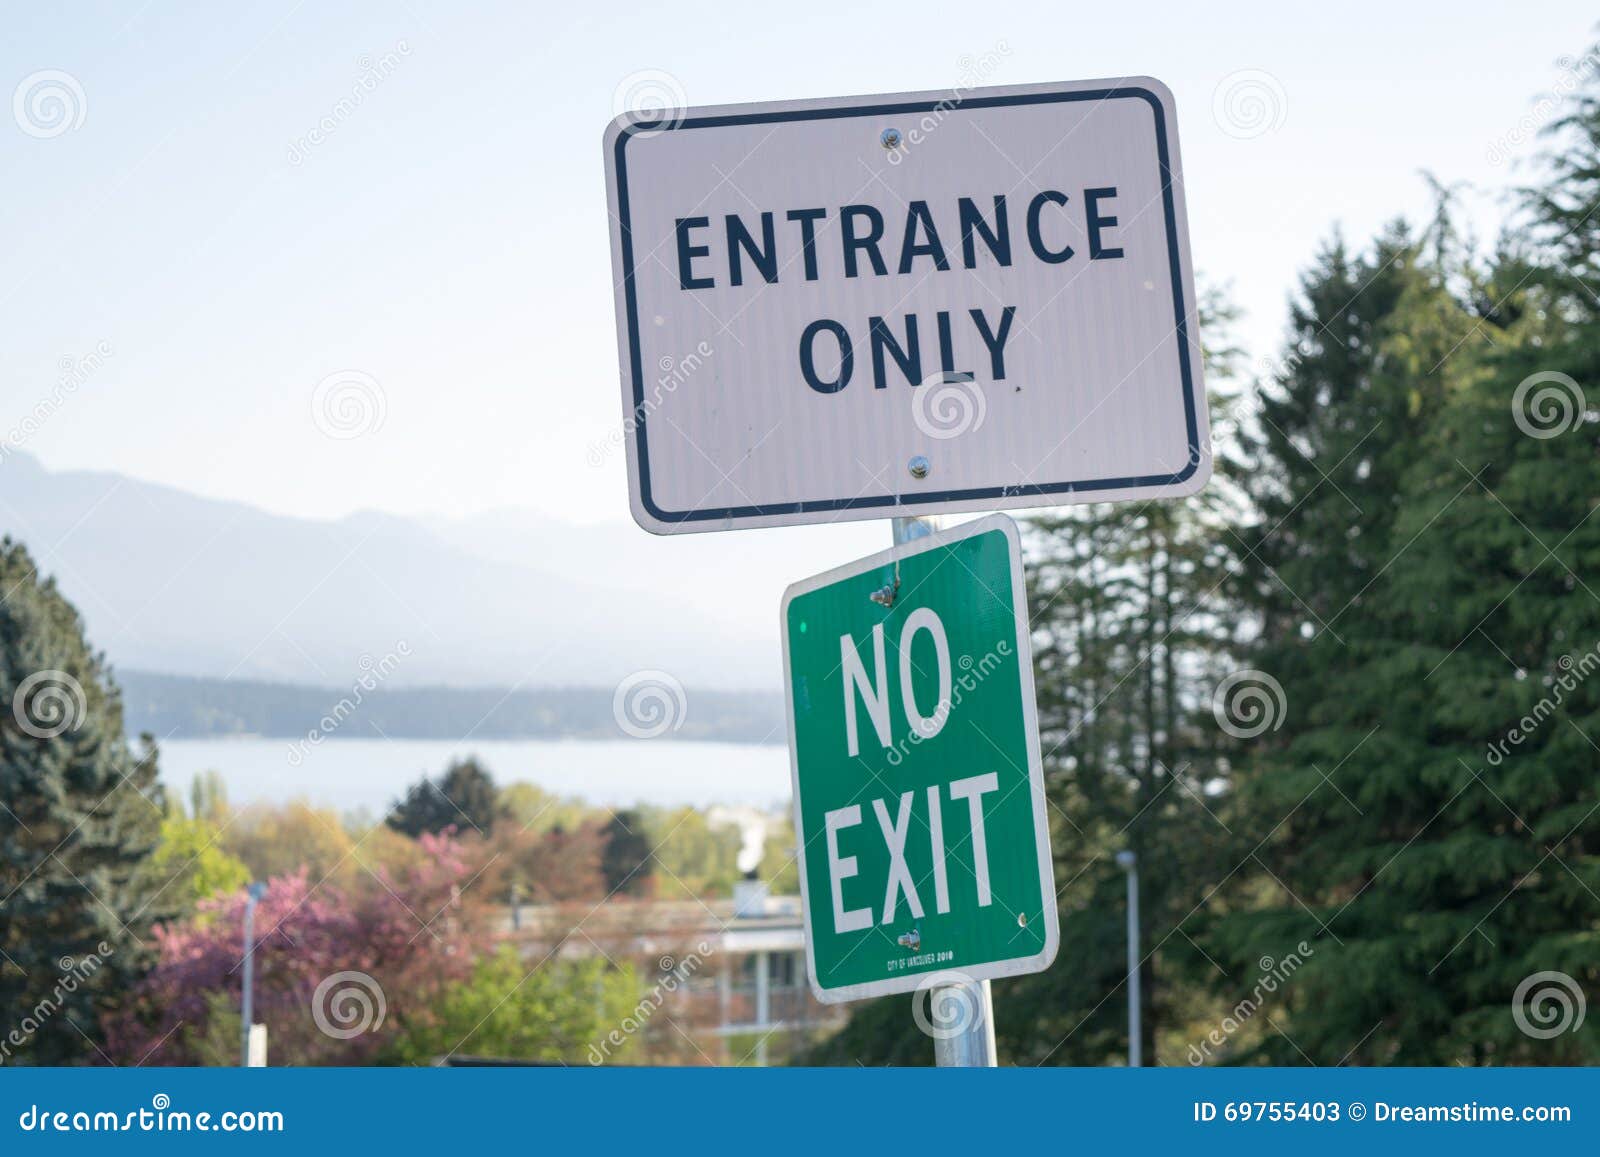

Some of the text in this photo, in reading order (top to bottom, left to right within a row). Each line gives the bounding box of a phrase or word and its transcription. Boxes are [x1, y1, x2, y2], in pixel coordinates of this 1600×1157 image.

[675, 187, 1124, 290] ENTRANCE
[800, 306, 1016, 393] ONLY
[840, 607, 952, 757] NO
[824, 771, 999, 934] EXIT
